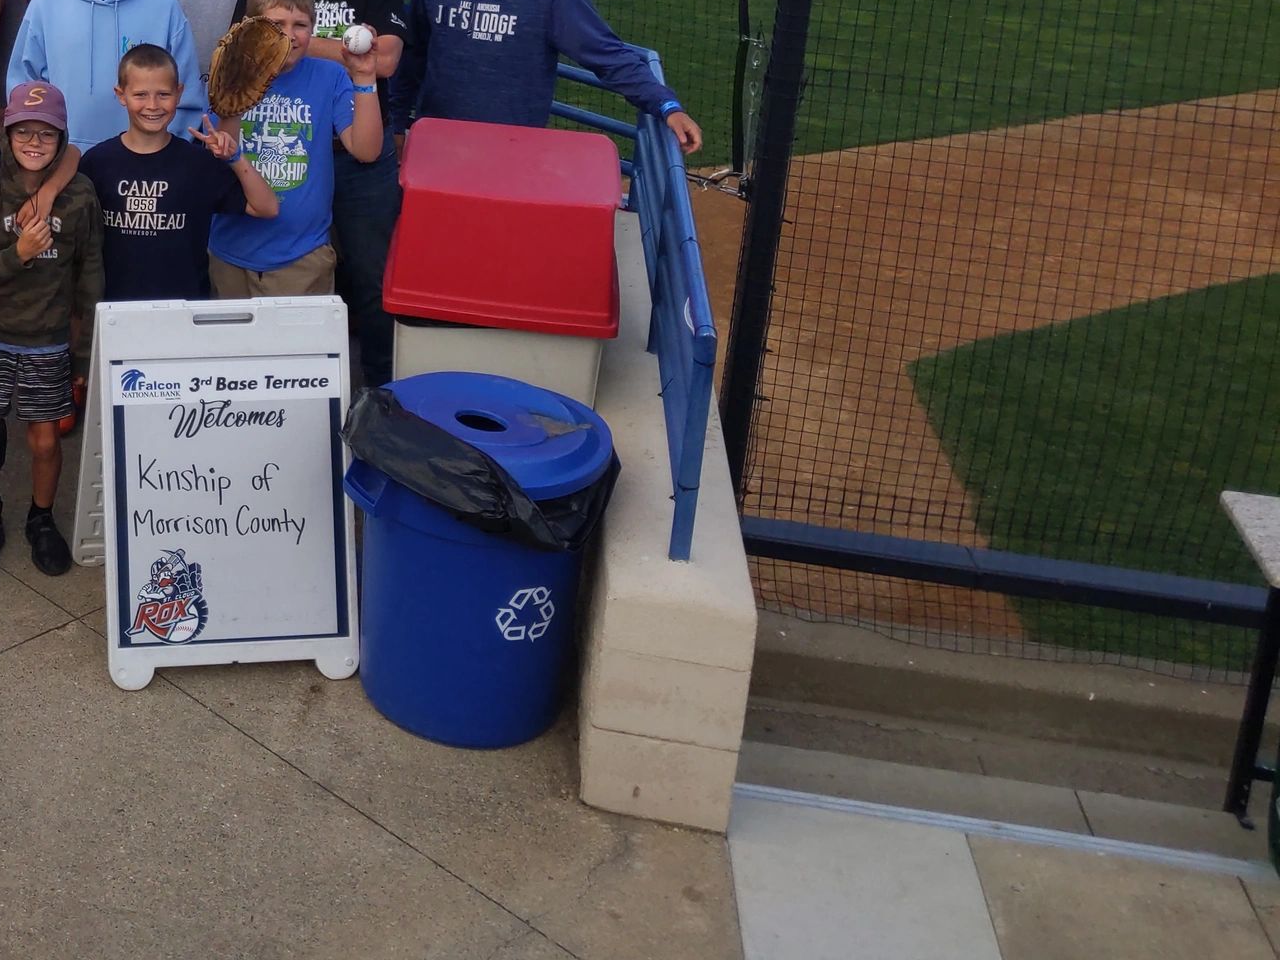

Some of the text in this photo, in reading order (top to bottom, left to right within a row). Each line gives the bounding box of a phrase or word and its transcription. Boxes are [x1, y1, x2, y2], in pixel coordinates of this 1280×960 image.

[460, 0, 471, 10] LAKE
[314, 8, 356, 27] ERENCE
[473, 11, 518, 36] LODGE
[23, 87, 47, 106] S
[263, 95, 293, 106] aking
[259, 148, 288, 164] One
[117, 179, 169, 198] CAMP
[128, 198, 155, 211] 1958
[121, 229, 158, 237] MINNESOTA
[138, 374, 329, 393] Falcon 3rd Base Terrace
[121, 391, 159, 399] NATIONAL
[160, 390, 181, 398] BANK
[169, 398, 287, 439] Welcomes
[138, 453, 280, 506] Kinship of
[133, 504, 306, 545] Morrison County
[175, 590, 195, 600] CLOUD
[125, 595, 200, 640] ROX
